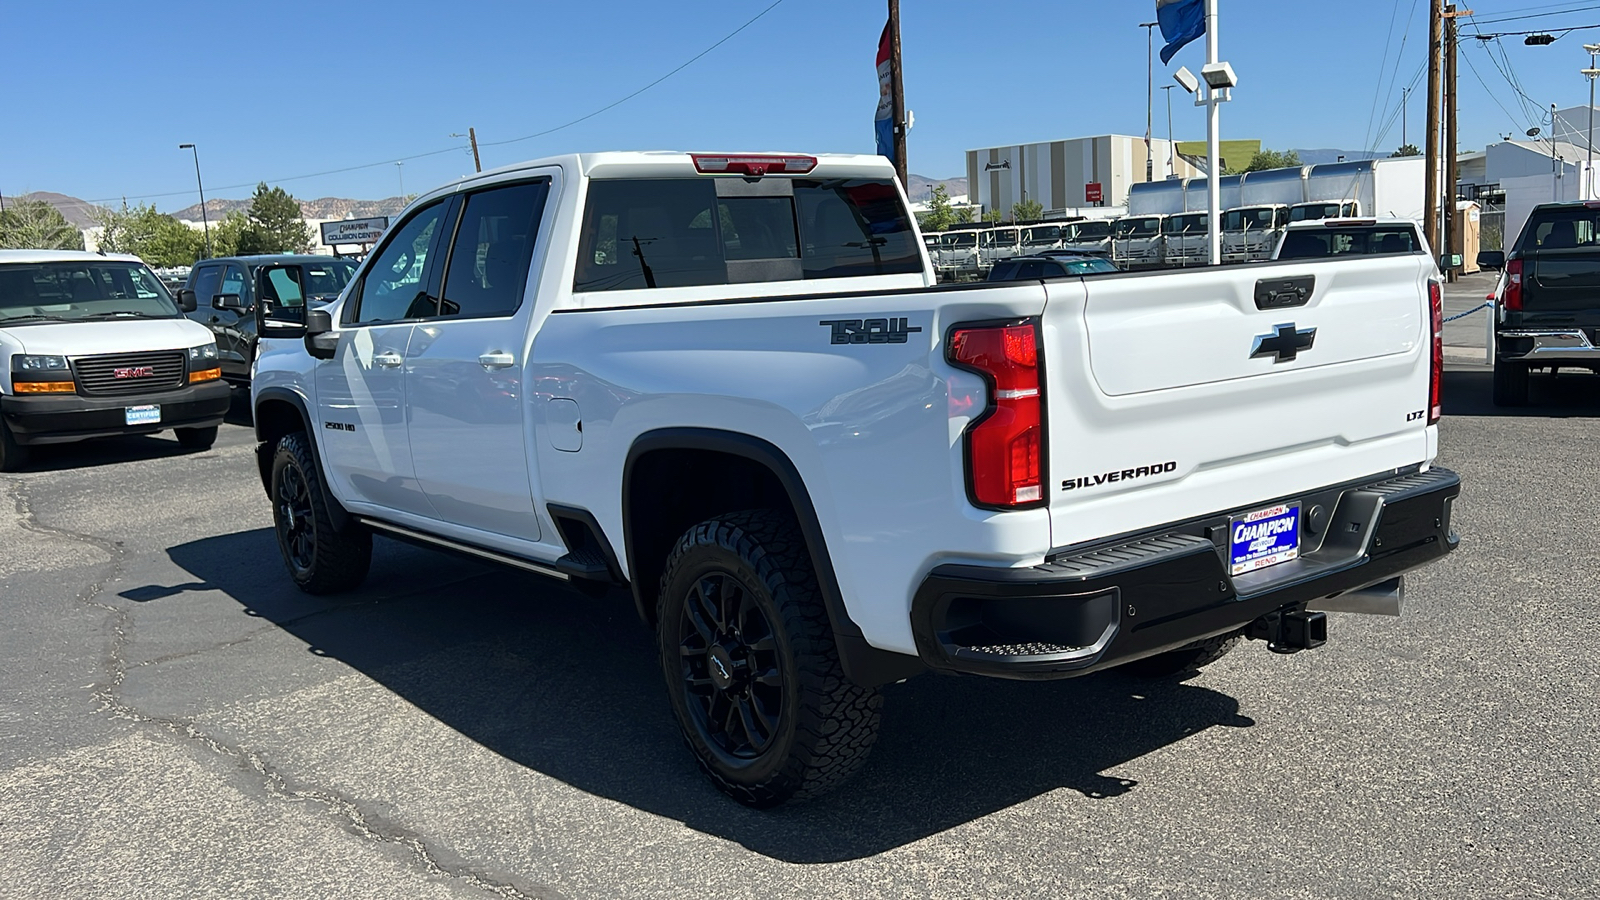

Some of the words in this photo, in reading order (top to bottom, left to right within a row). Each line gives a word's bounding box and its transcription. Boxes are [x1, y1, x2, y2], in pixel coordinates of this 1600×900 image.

[340, 223, 369, 233] CHAMPION
[328, 233, 358, 241] COLLISION
[819, 317, 922, 333] TRAIL
[830, 333, 908, 345] BOSS
[114, 366, 154, 379] GMC
[1406, 409, 1425, 422] LTZ
[1061, 461, 1177, 491] SILVERADO
[1250, 507, 1283, 520] CHAMPION
[1233, 516, 1295, 544] CHAMPION
[1254, 556, 1277, 567] RENO
